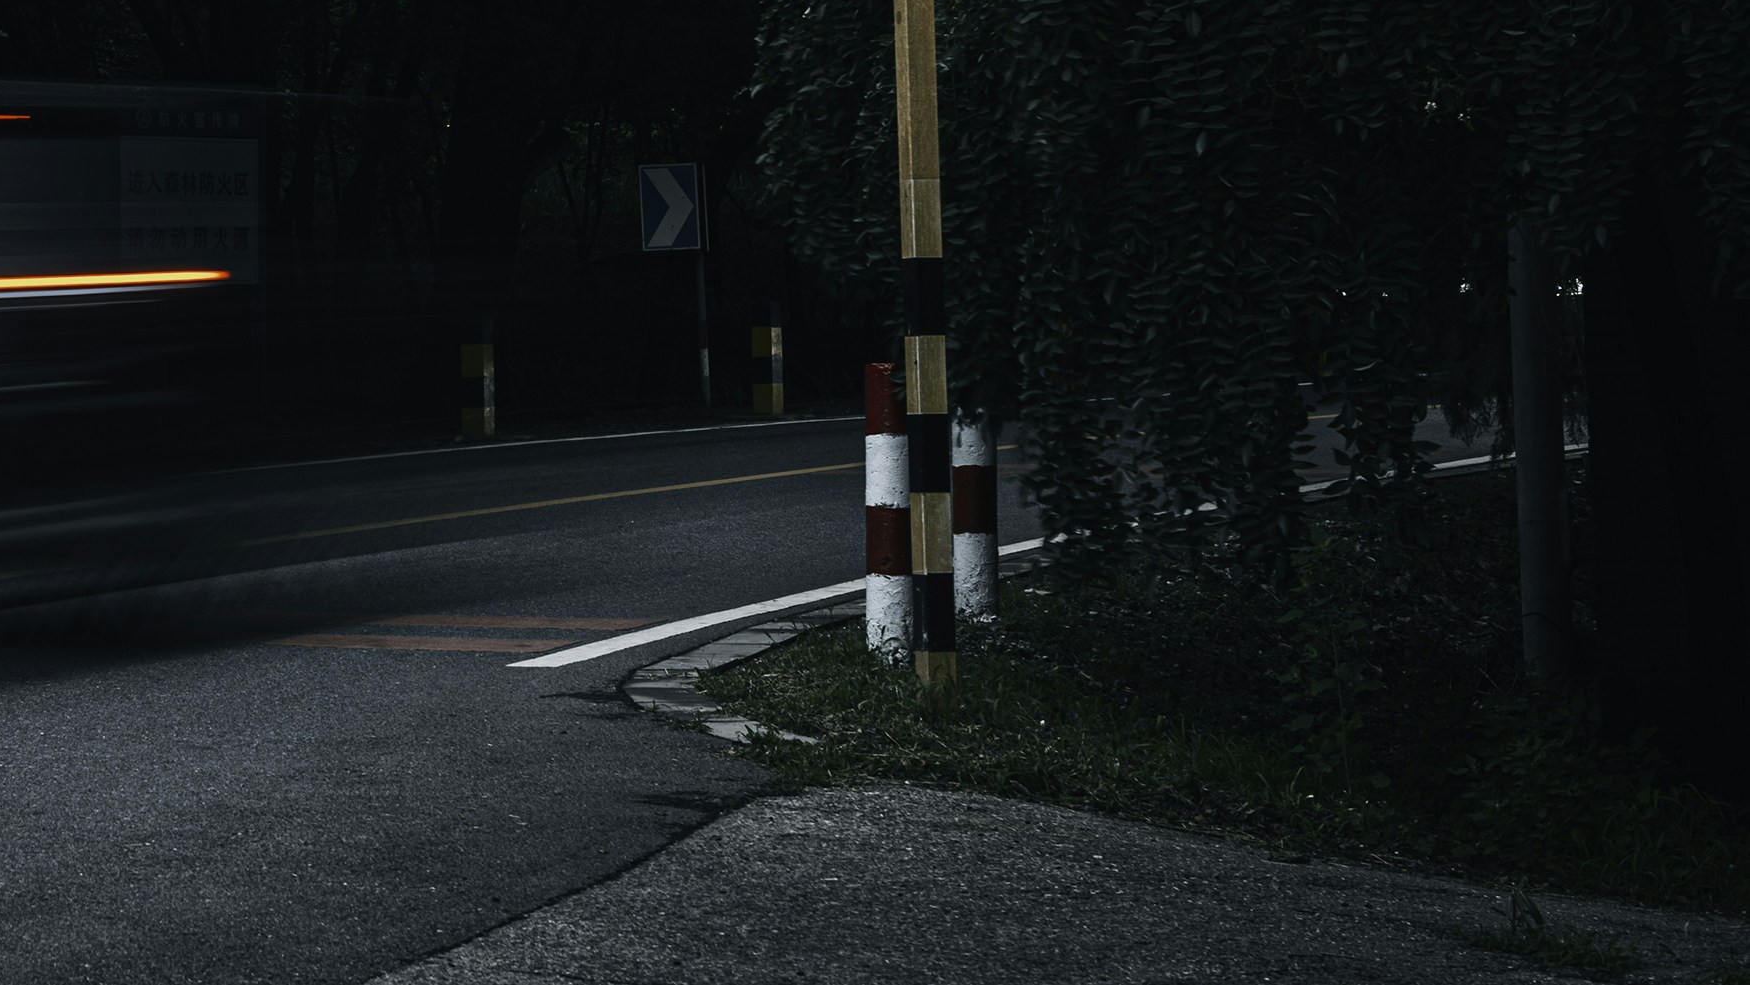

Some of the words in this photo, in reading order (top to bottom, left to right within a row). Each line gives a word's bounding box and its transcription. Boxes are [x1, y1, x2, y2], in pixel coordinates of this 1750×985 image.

[128, 170, 249, 196] 进入森林防火区
[128, 226, 250, 250] 请勿动用火源
